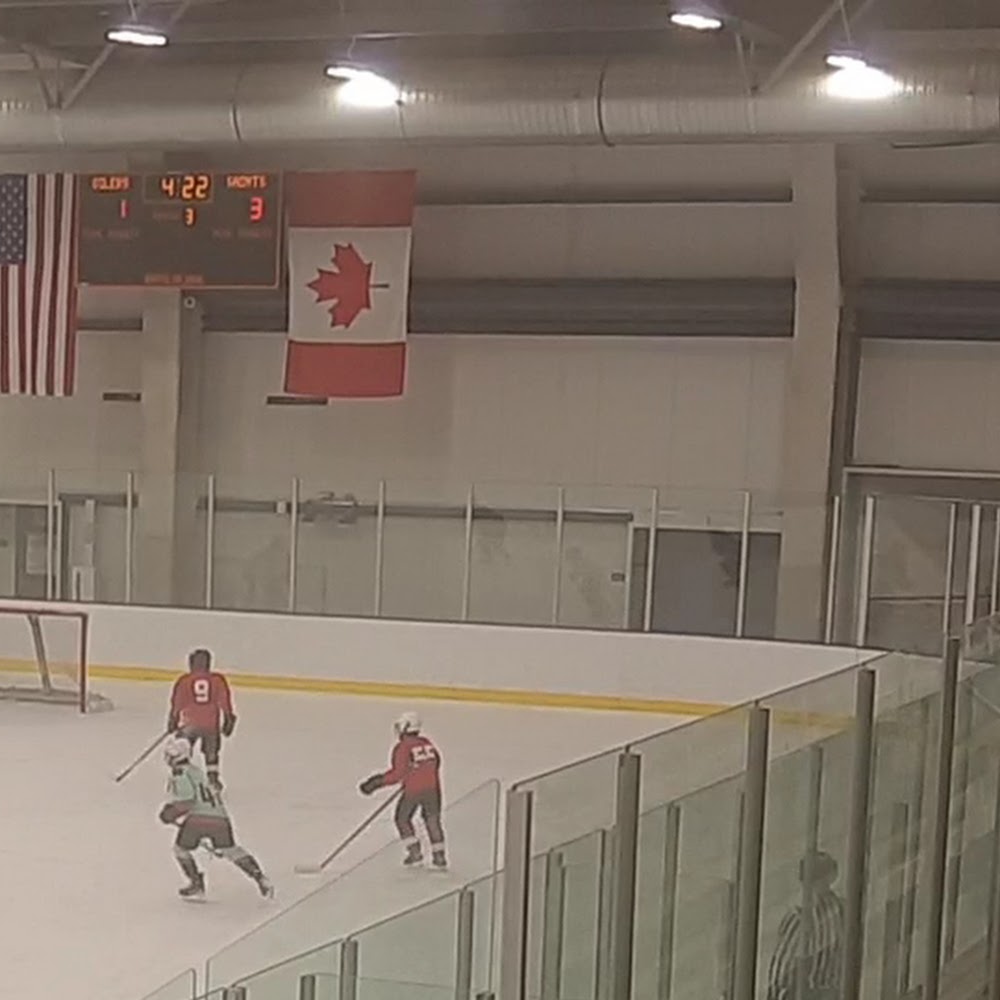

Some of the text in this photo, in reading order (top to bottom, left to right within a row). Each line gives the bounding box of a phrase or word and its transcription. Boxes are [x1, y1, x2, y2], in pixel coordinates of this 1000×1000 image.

[120, 199, 127, 218] 1
[250, 197, 264, 220] 3
[193, 679, 210, 702] 9
